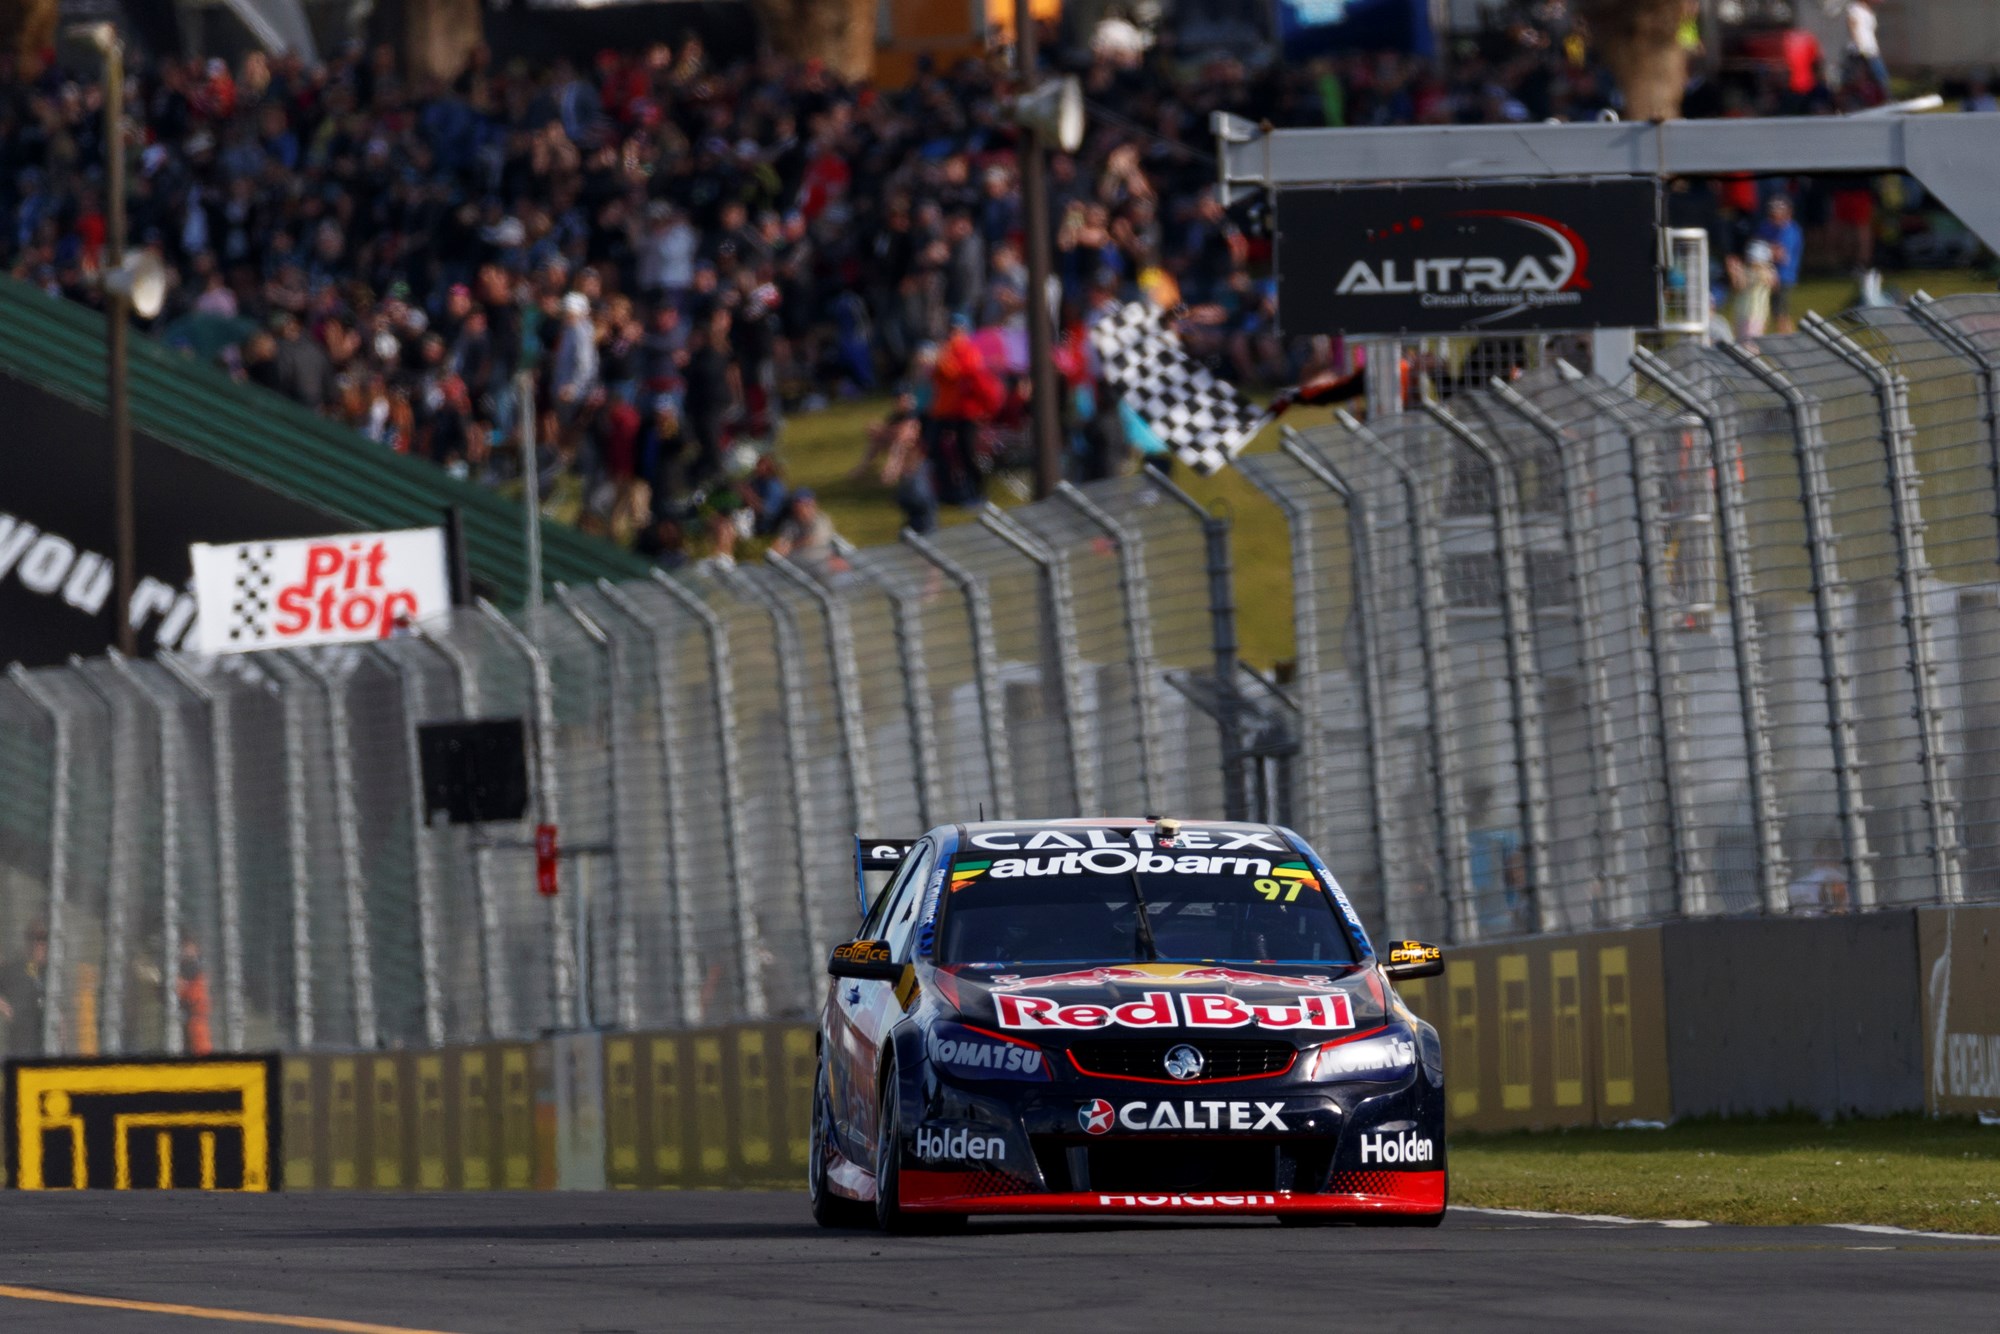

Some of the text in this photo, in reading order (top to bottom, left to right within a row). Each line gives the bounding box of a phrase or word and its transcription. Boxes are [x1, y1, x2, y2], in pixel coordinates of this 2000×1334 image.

[304, 542, 386, 598] Pit
[275, 586, 417, 640] Stop
[1253, 878, 1303, 901] 97
[834, 946, 890, 960] EDIFICE
[995, 992, 1355, 1030] Red Bull
[929, 1039, 1042, 1074] KOMATSU
[1119, 1101, 1290, 1131] CALTEX
[916, 1127, 1005, 1160] Holden
[1361, 1131, 1433, 1163] Holden
